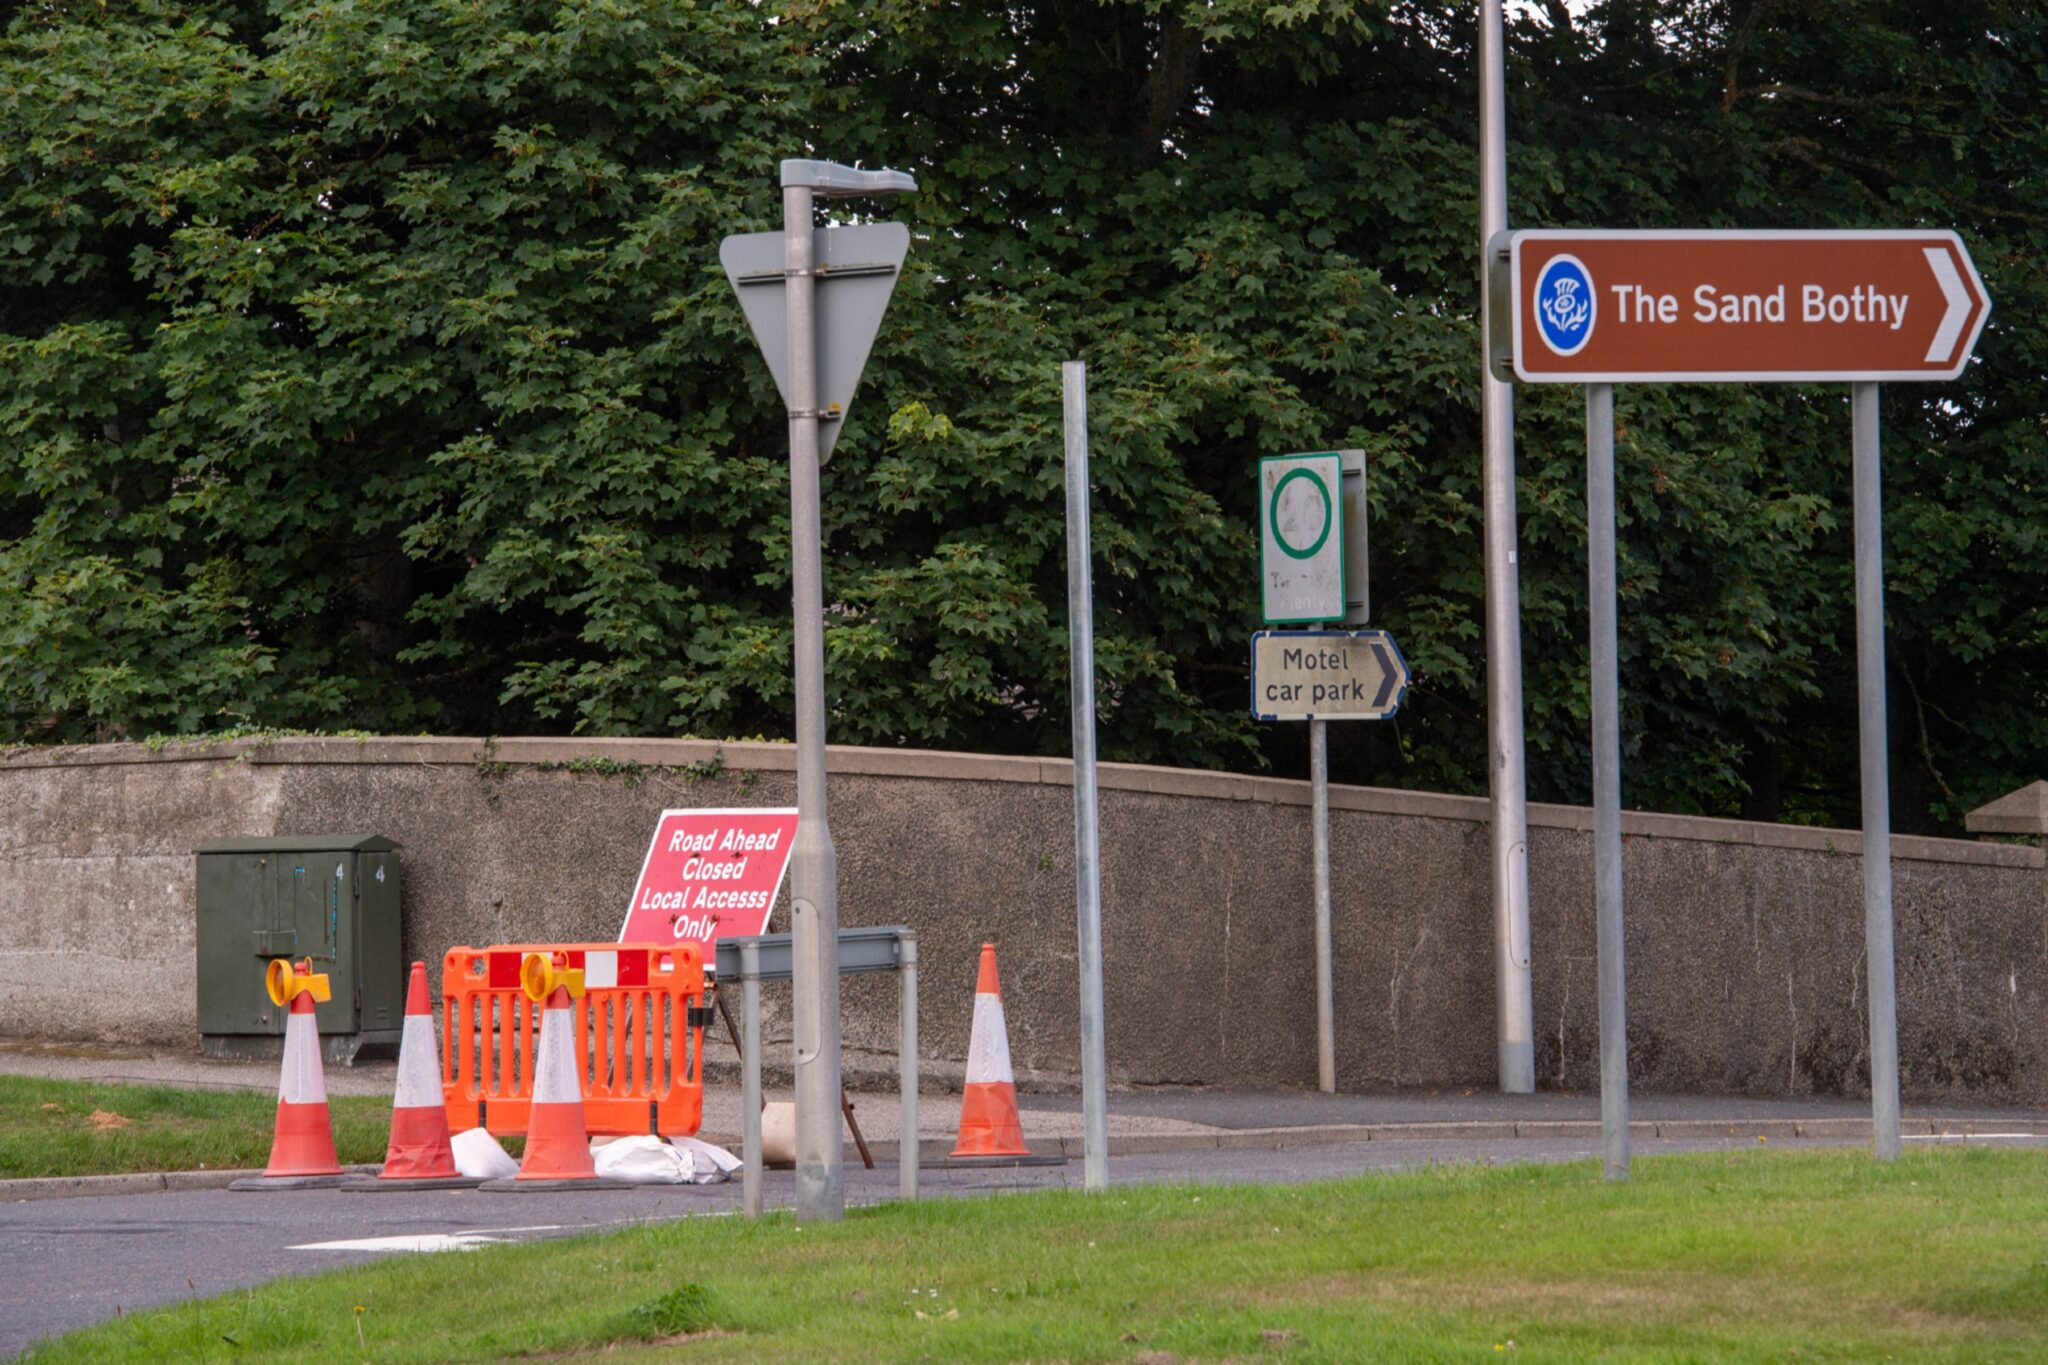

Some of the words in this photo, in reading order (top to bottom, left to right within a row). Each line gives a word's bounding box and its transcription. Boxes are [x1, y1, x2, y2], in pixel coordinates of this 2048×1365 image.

[1611, 284, 1678, 323] The
[1693, 284, 1786, 323] Sand
[1802, 284, 1909, 330] Bothy
[1283, 648, 1349, 671] Motel
[1266, 683, 1303, 701] car
[1312, 678, 1364, 704] park
[668, 829, 718, 852] Road
[719, 828, 781, 851] Ahead
[336, 863, 344, 880] 4
[376, 864, 385, 882] 4
[682, 857, 748, 880] Closed
[640, 886, 690, 910] Local
[692, 886, 768, 909] Accesss
[673, 914, 718, 942] Only
